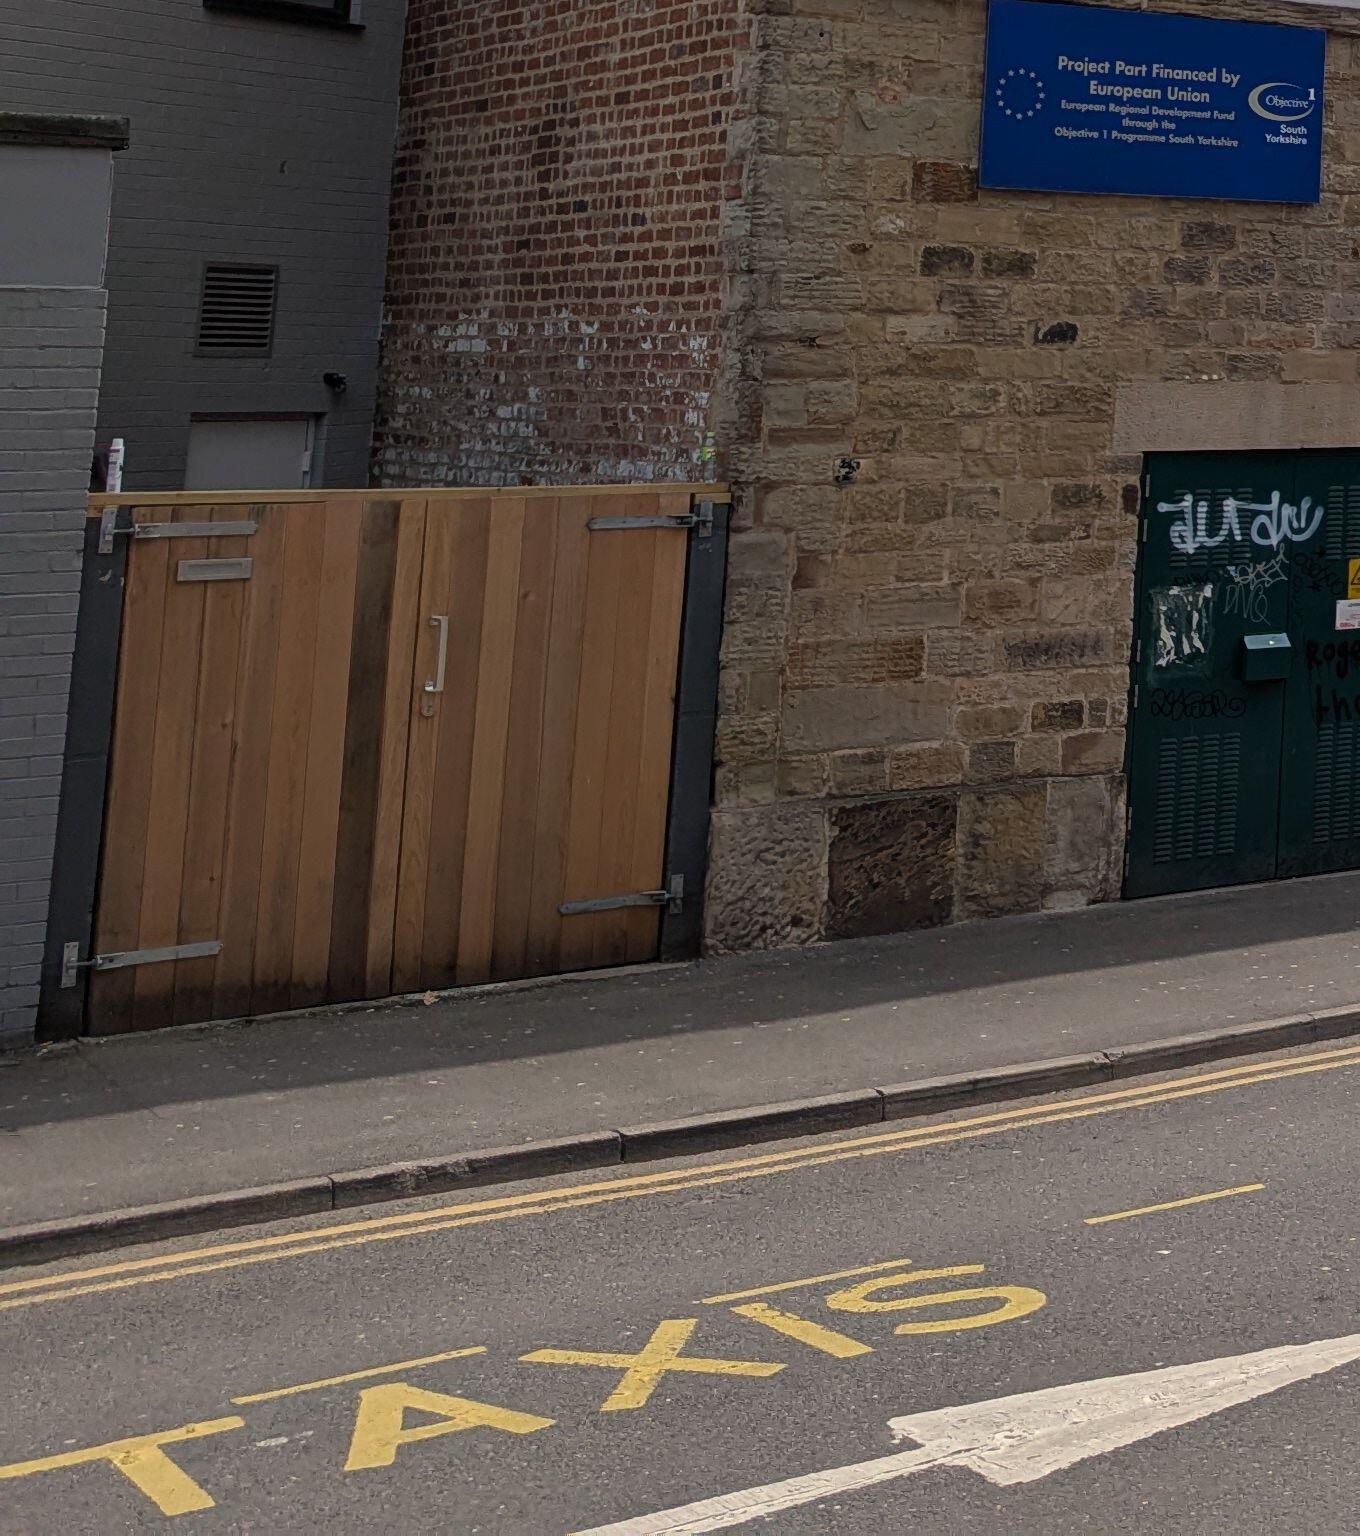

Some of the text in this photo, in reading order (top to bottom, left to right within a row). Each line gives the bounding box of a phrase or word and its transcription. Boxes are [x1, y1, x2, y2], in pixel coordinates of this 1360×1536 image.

[1057, 55, 1241, 88] Project Part Financed by
[1089, 80, 1210, 103] European Union
[1307, 88, 1316, 101] 1
[1061, 100, 1235, 121] European Regional Development Fund
[1122, 117, 1177, 131] through the
[1280, 124, 1308, 135] South
[1054, 126, 1239, 148] Objective 1 Programme South Yorkshire
[1265, 133, 1308, 145] Yorkshire
[0, 1263, 1048, 1517] TAXIS
